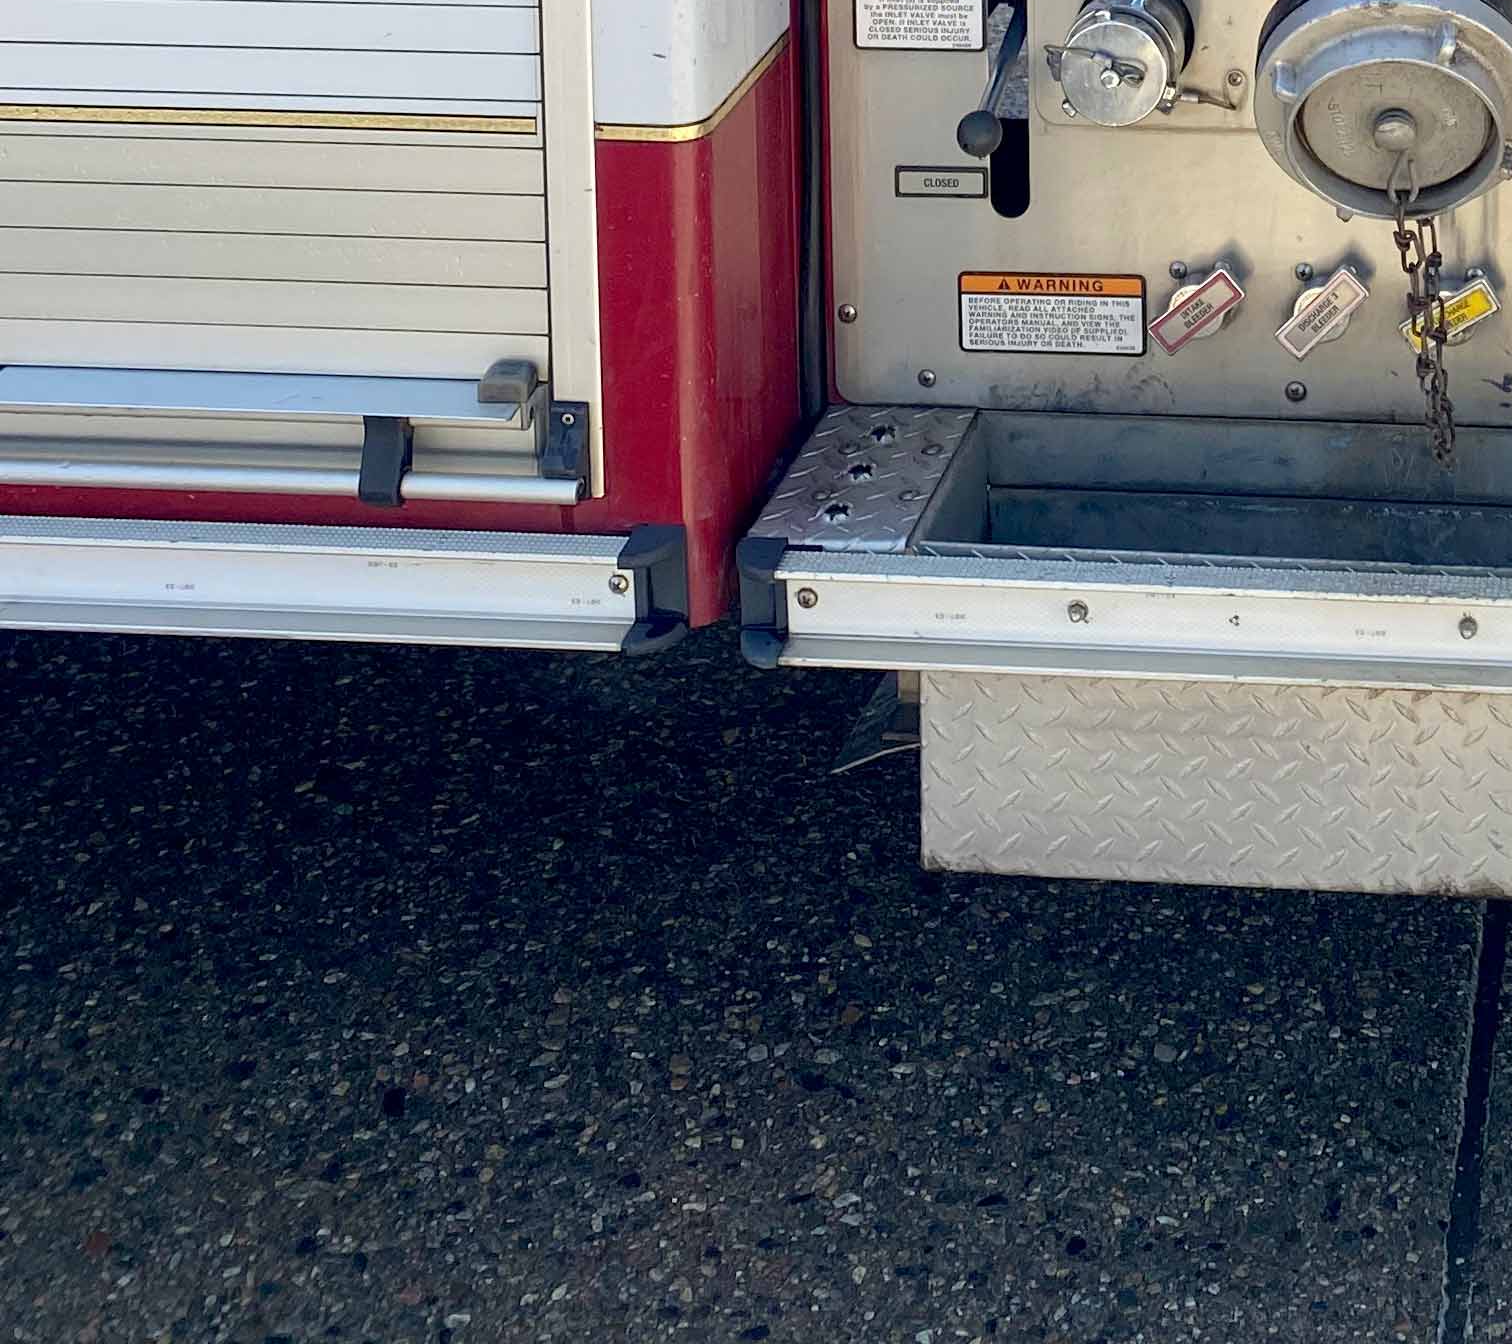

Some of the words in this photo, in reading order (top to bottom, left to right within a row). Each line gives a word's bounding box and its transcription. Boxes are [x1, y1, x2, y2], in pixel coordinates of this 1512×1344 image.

[868, 25, 901, 33] CLOSED
[881, 33, 908, 41] DEATH
[923, 178, 960, 188] CLOSED
[1017, 279, 1104, 292] WARNING
[1180, 299, 1204, 320] INTAKE
[1184, 303, 1215, 329] BLEEDER
[1298, 300, 1333, 332] DISCHARGE
[1311, 305, 1340, 333] BLEEDER
